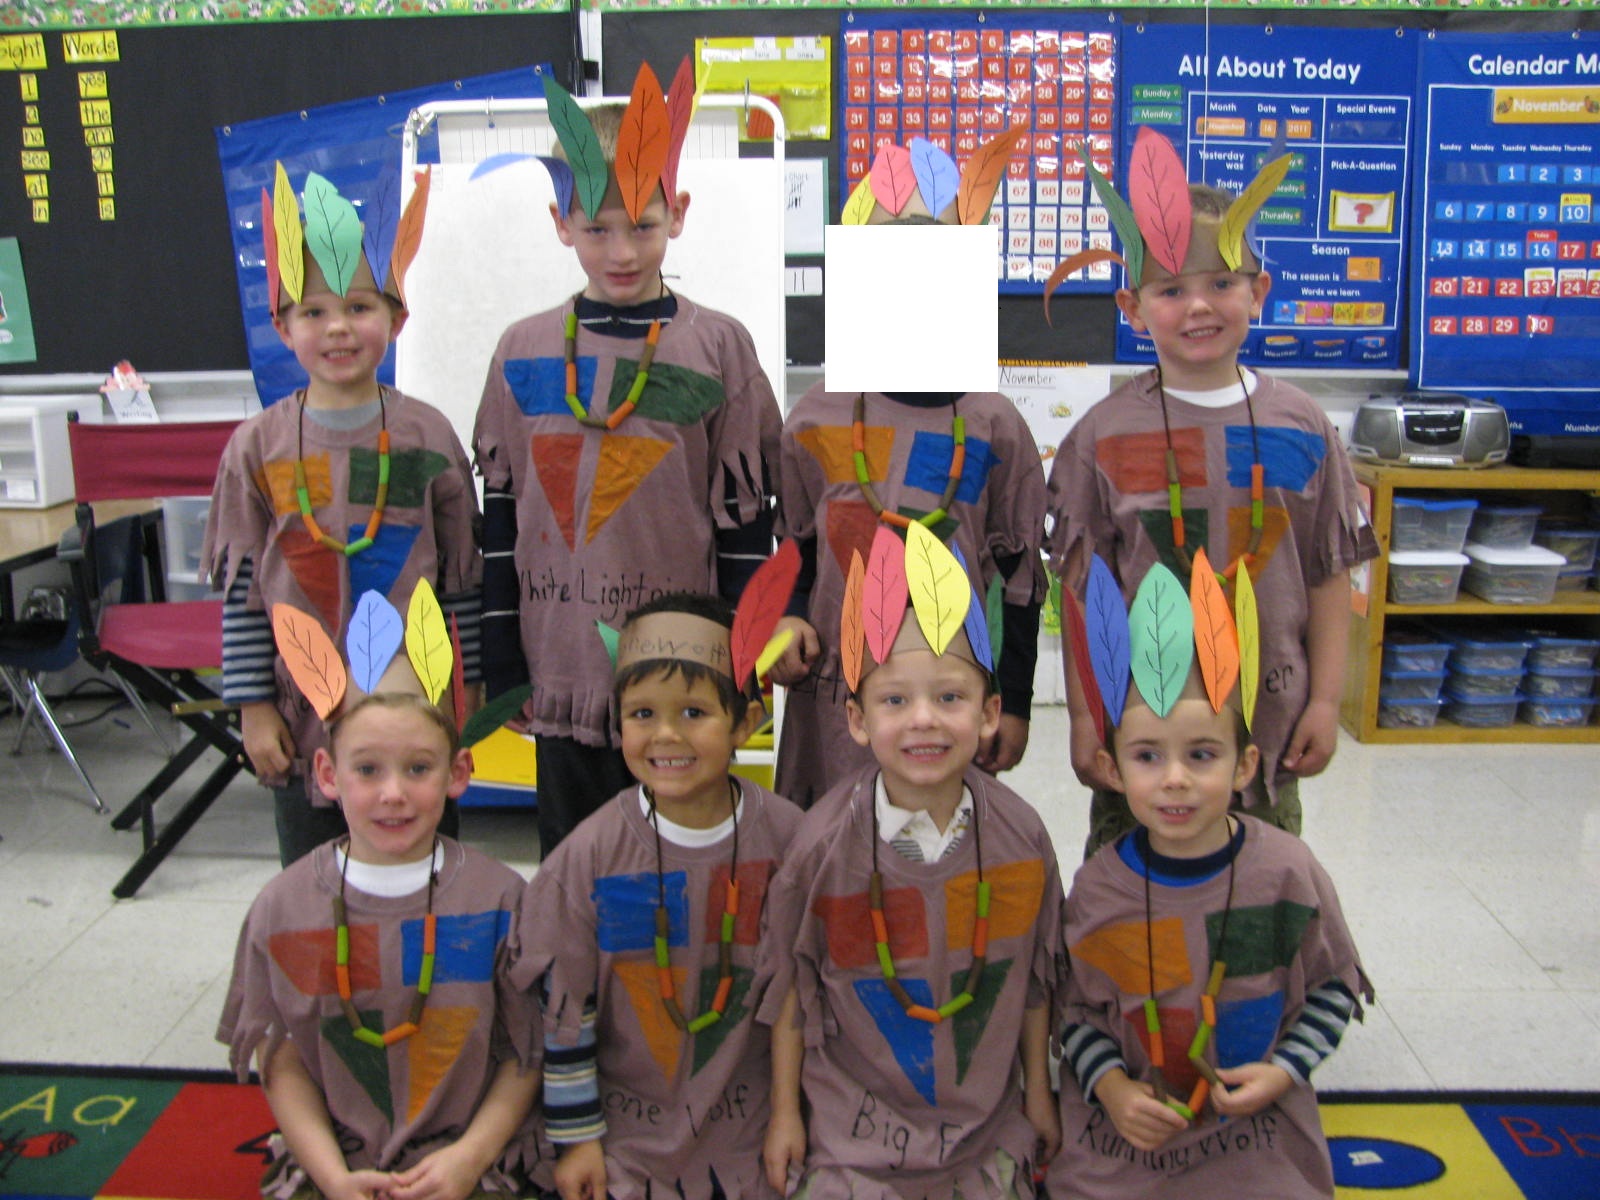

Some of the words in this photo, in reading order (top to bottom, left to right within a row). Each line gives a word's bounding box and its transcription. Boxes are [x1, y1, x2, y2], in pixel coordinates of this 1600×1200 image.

[64, 32, 116, 56] Words
[882, 37, 890, 48] 2
[909, 37, 918, 48] 3
[936, 37, 945, 48] 4
[963, 37, 971, 48] 5
[988, 37, 997, 48] 6
[854, 62, 864, 74] 11
[880, 62, 891, 74] 12
[908, 62, 920, 74] 13
[988, 63, 1000, 74] 16
[1014, 63, 1026, 74] 17
[1178, 54, 1208, 77] All
[1216, 55, 1286, 78] About
[1292, 57, 1361, 85] Today
[1468, 54, 1570, 75] Calendar
[1575, 54, 1600, 74] M
[80, 71, 105, 97] yes
[854, 87, 866, 99] 21
[907, 87, 922, 99] 23
[932, 87, 947, 99] 24
[1038, 88, 1053, 99] 28
[1065, 88, 1081, 99] 29
[1142, 88, 1172, 98] Sunday
[1209, 101, 1237, 113] Month
[1257, 103, 1277, 113] Date
[1290, 104, 1311, 114] Year
[1336, 103, 1366, 115] Special
[1368, 104, 1396, 114] Events
[1512, 98, 1585, 113] November
[83, 103, 109, 125] the
[850, 113, 863, 124] 31
[878, 113, 893, 124] 32
[906, 113, 920, 124] 33
[931, 113, 946, 124] 34
[959, 113, 974, 124] 35
[984, 113, 999, 124] 36
[1012, 113, 1027, 124] 37
[1039, 113, 1054, 124] 38
[1065, 113, 1079, 125] 39
[1091, 113, 1107, 125] 40
[1141, 109, 1173, 119] Monday
[853, 138, 865, 149] 41
[958, 138, 974, 150] 45
[1036, 138, 1052, 150] 48
[1439, 143, 1462, 152] Sunday
[1470, 143, 1494, 152] Monday
[1502, 143, 1527, 152] Tuesday
[1530, 144, 1562, 152] Wednesday
[1564, 144, 1592, 152] Thursday
[1198, 150, 1245, 161] Yesterday
[851, 162, 864, 174] 51
[1010, 163, 1025, 174] 57
[1225, 162, 1244, 171] was
[1330, 160, 1397, 171] Pick-A-Question
[1508, 167, 1515, 180] 1
[1539, 168, 1548, 181] 2
[1573, 168, 1582, 181] 3
[1216, 178, 1244, 190] Today
[1012, 186, 1027, 196] 67
[1041, 187, 1057, 197] 68
[1066, 186, 1081, 197] 69
[1259, 211, 1294, 222] Thursday
[1445, 204, 1454, 218] 6
[1475, 204, 1485, 218] 7
[1506, 205, 1515, 219] 8
[1538, 206, 1548, 220] 9
[1566, 206, 1584, 220] 10
[1012, 214, 1027, 223] 77
[1039, 213, 1054, 223] 78
[1065, 213, 1080, 224] 79
[1090, 214, 1106, 224] 80
[1012, 238, 1028, 248] 87
[1038, 238, 1054, 248] 88
[1064, 238, 1079, 249] 89
[1311, 244, 1350, 256] Season
[1467, 243, 1485, 257] 14
[1499, 243, 1517, 257] 15
[1533, 243, 1550, 257] 16
[1562, 244, 1580, 258] 17
[1010, 262, 1025, 271] 97
[1281, 271, 1297, 281] The
[1299, 273, 1329, 281] season
[1332, 272, 1340, 281] is
[1301, 287, 1325, 297] Words
[1326, 289, 1338, 297] we
[1339, 287, 1360, 297] learn
[1433, 282, 1453, 294] 20
[1466, 282, 1483, 294] 21
[1499, 282, 1517, 294] 22
[1532, 282, 1550, 294] 23
[1563, 282, 1581, 295] 24
[1433, 320, 1451, 332] 27
[1465, 320, 1484, 332] 28
[1495, 320, 1513, 332] 29
[999, 367, 1053, 385] November
[520, 568, 571, 602] hite
[605, 1091, 661, 1126] one
[851, 1088, 910, 1171] Big
